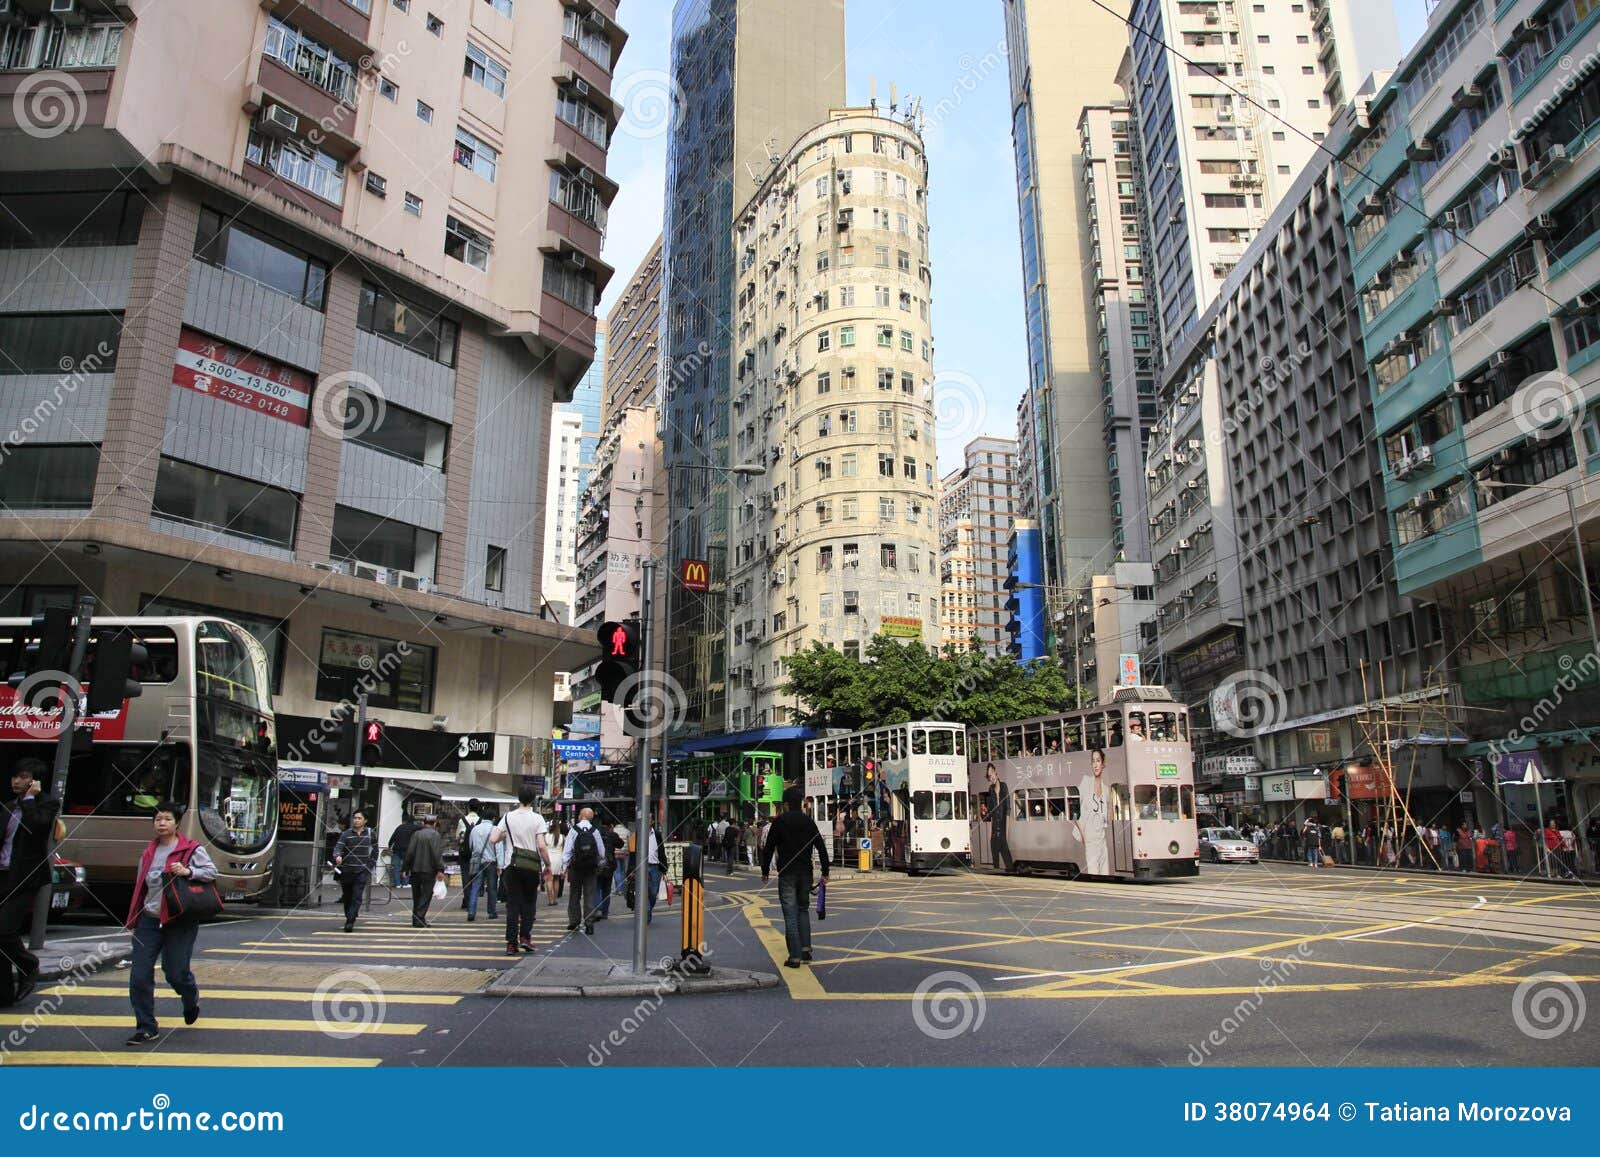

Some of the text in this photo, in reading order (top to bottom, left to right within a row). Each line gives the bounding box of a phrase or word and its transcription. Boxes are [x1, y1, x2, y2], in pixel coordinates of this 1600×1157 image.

[257, 398, 289, 417] 0148
[4, 720, 15, 729] FA
[16, 721, 32, 729] CUP
[470, 739, 489, 755] Shop
[928, 758, 956, 766] BALLY
[280, 803, 308, 814] Wi-Fi
